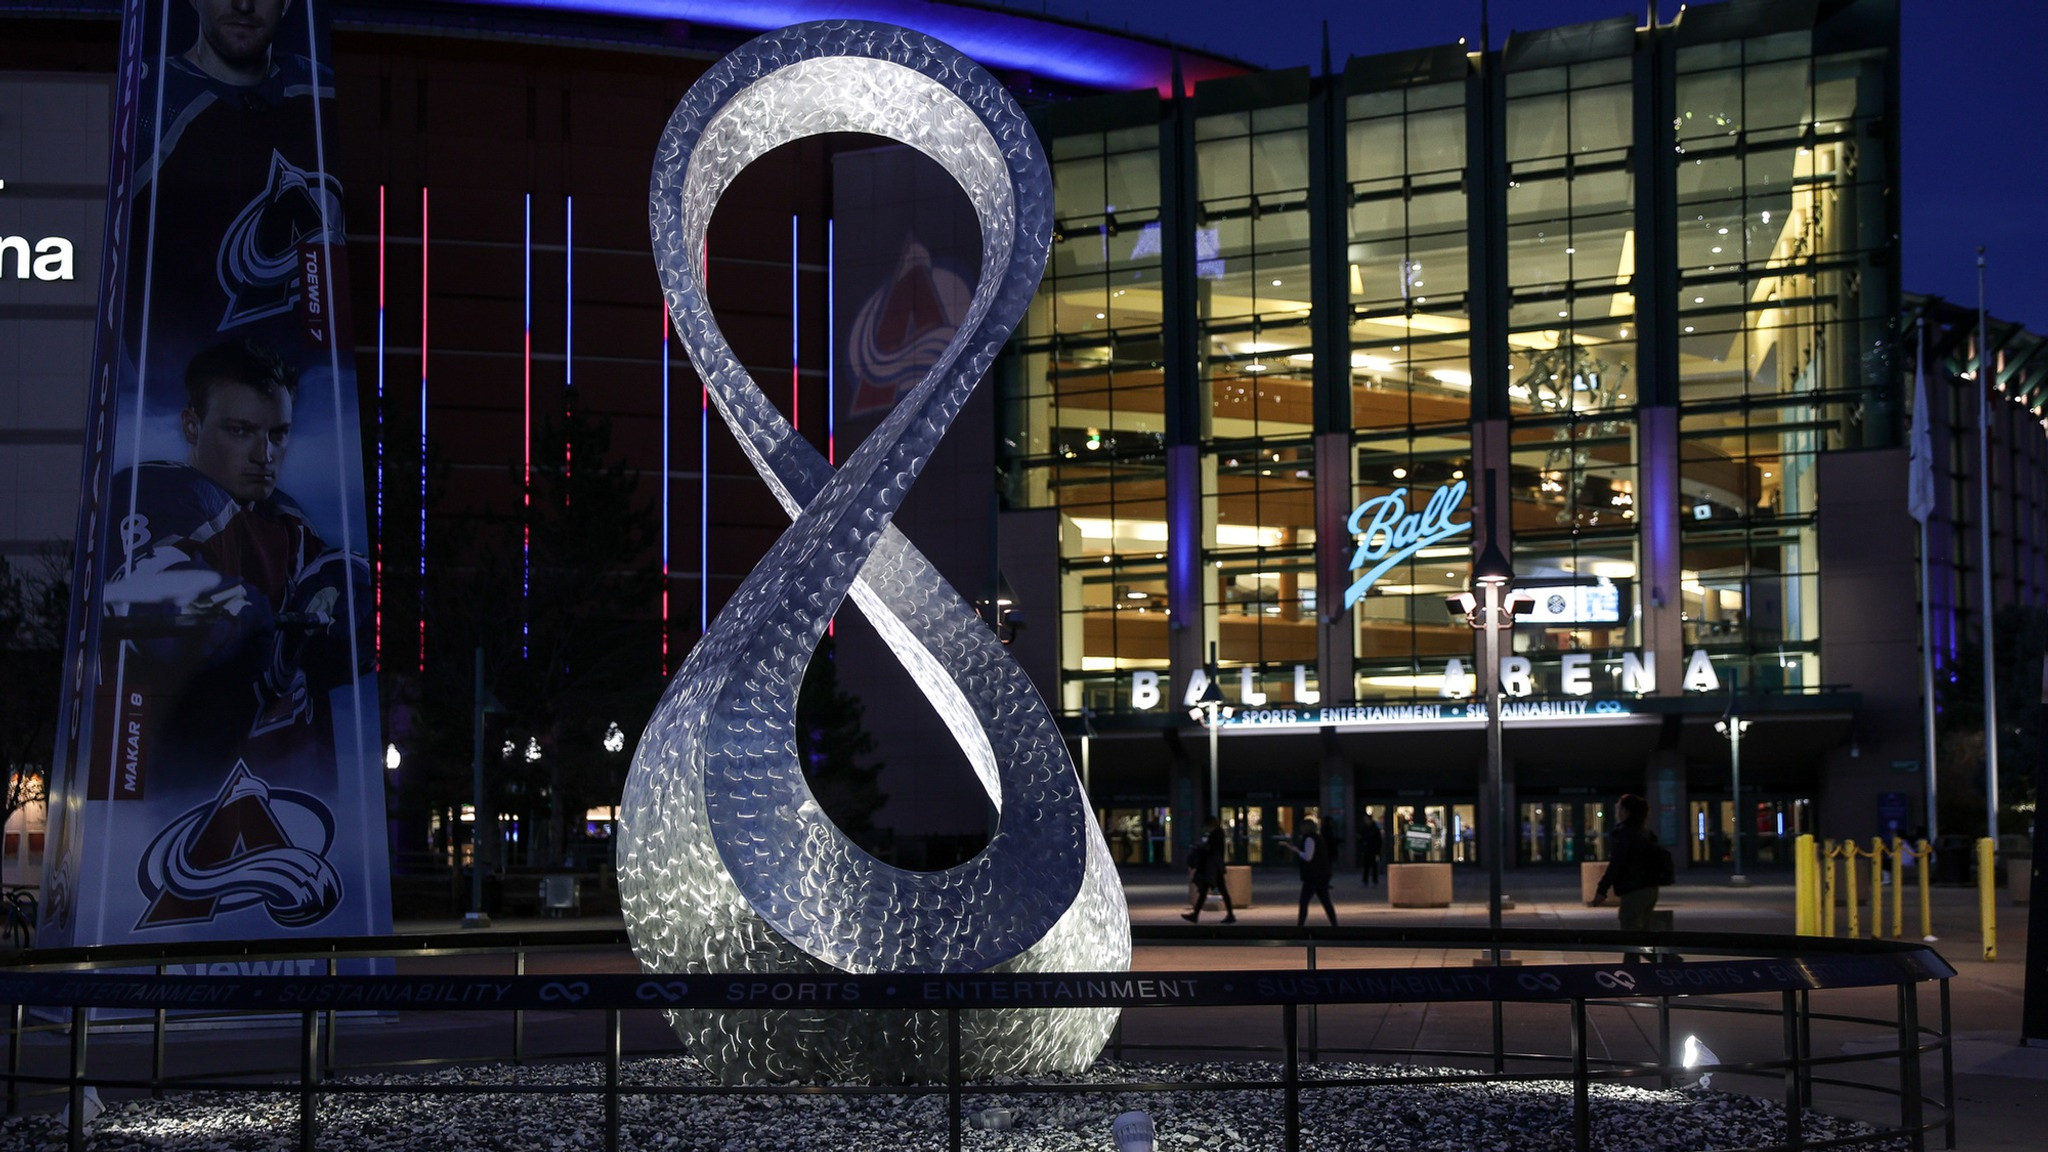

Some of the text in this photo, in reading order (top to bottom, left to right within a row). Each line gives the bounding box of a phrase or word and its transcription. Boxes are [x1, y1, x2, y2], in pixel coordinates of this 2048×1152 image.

[107, 0, 139, 331] AVALANC
[305, 250, 323, 342] TOEWS 7
[1346, 480, 1473, 590] Ball
[1131, 649, 1721, 710] BALL ARENA
[1241, 700, 1588, 725] SPORTS ENTERTAINMENT SUAINABILITY
[124, 720, 141, 792] MAKAR
[54, 981, 241, 1002] ENTERTAINMENT
[278, 982, 512, 1003] SUSTAINABILITY
[725, 973, 1494, 1002] SPORTS ENTERTAINMENT SUSTAINABILITY
[1655, 966, 1744, 987] SPORTS
